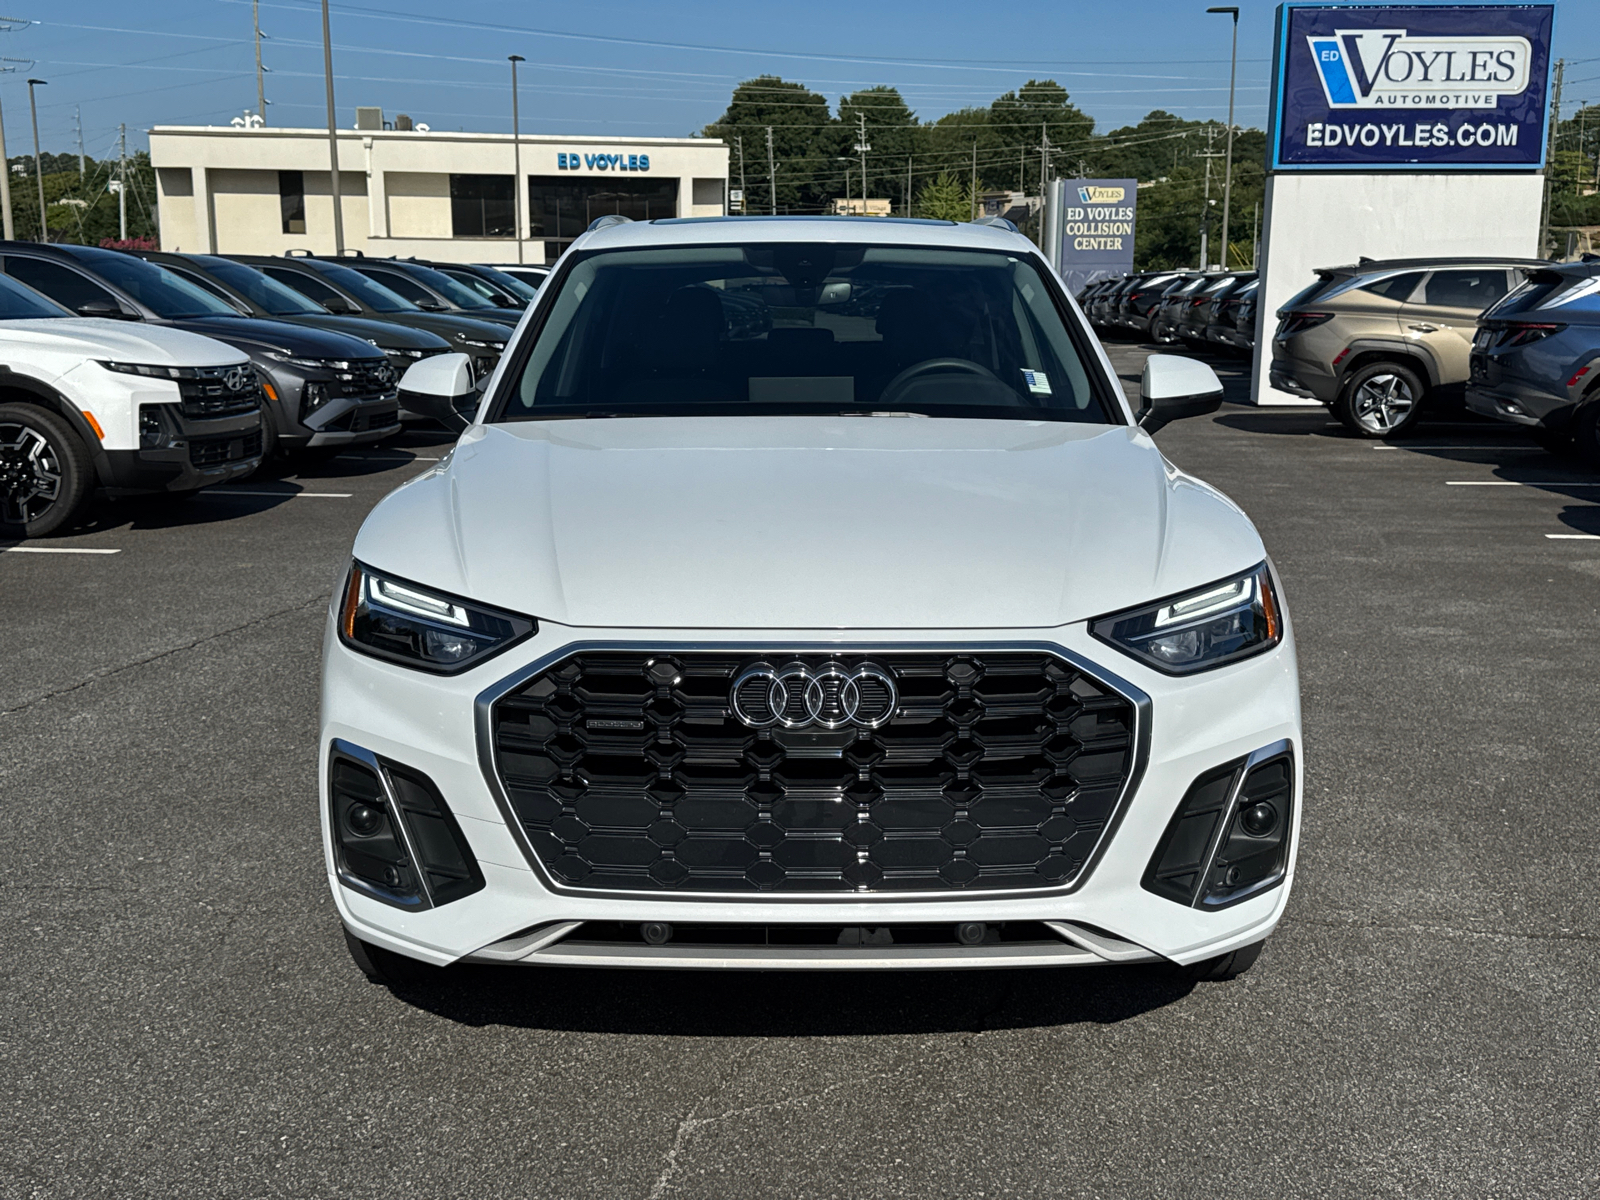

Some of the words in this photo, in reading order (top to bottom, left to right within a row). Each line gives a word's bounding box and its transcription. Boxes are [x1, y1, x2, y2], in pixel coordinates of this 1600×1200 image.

[1321, 50, 1339, 61] ED
[1341, 34, 1516, 98] VOYLES
[1374, 95, 1494, 105] AUTOMOTIVE
[1306, 123, 1519, 147] EDVOYLES.COM
[557, 152, 581, 170] ED
[584, 153, 650, 172] VOYLES
[1066, 207, 1085, 220] ED
[1087, 207, 1134, 220] VOYLES
[1066, 222, 1133, 235] COLLISION
[1073, 237, 1123, 250] CENTER
